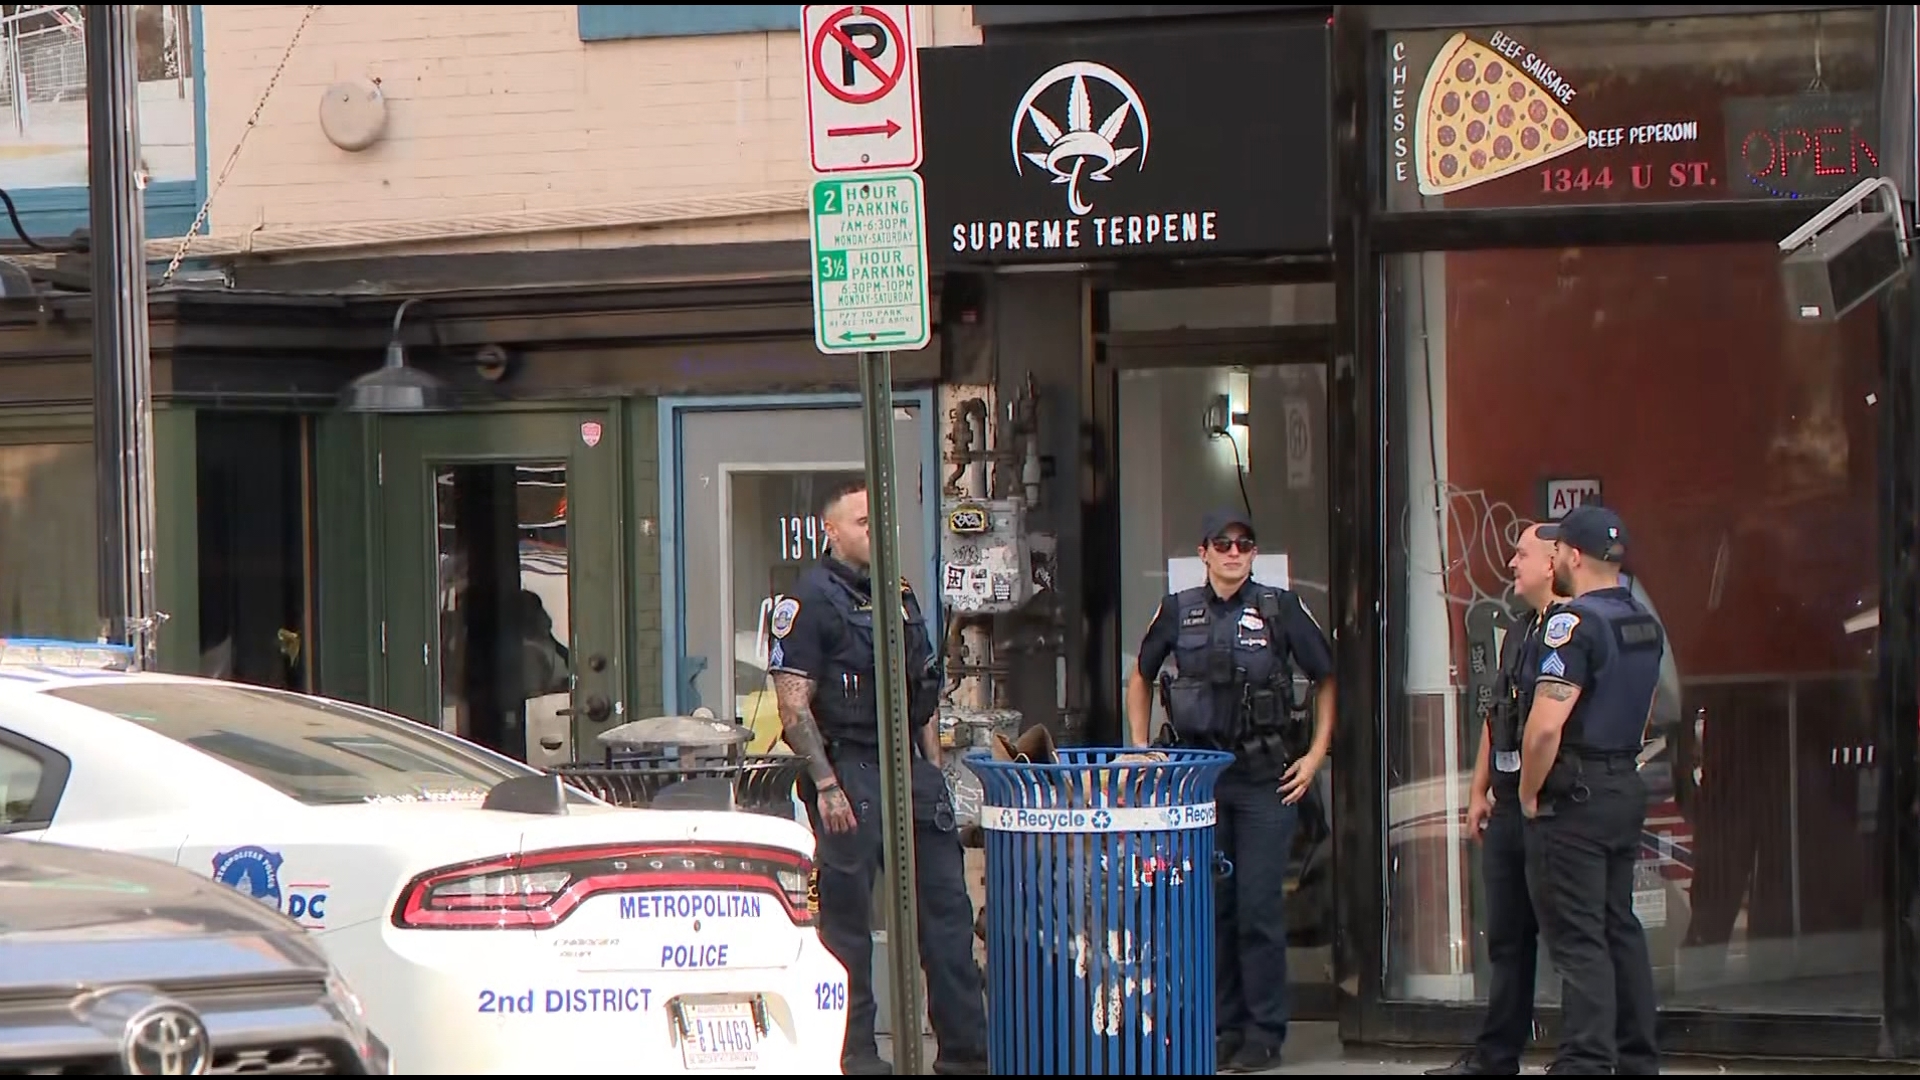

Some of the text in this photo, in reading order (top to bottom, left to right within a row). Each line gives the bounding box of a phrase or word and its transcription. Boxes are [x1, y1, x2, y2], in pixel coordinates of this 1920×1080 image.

[1490, 30, 1577, 106] BEEF SAUSAGE
[1392, 42, 1408, 182] CHESSE
[1587, 122, 1698, 149] BEEF PEPERONI
[1541, 162, 1717, 194] 1344 U ST.
[823, 190, 836, 212] 2
[845, 186, 896, 200] HOUR
[847, 201, 909, 217] PARKING
[840, 218, 908, 232] 7AM-6:30PM
[952, 211, 1217, 252] SUPREME TERPENE
[834, 231, 914, 246] MONDAY-SATURDAY
[859, 251, 902, 265] HOUR
[851, 265, 915, 280] PARKING
[837, 292, 914, 306] MONDAY-SATURDAY
[1016, 804, 1216, 830] Recycle Recyc
[288, 894, 327, 919] DC
[619, 895, 761, 919] METROPOLITAN
[661, 945, 729, 968] POLICE
[478, 988, 652, 1014] 2nd DISTRICT
[814, 982, 845, 1011] 1219
[708, 1020, 752, 1052] 14463
